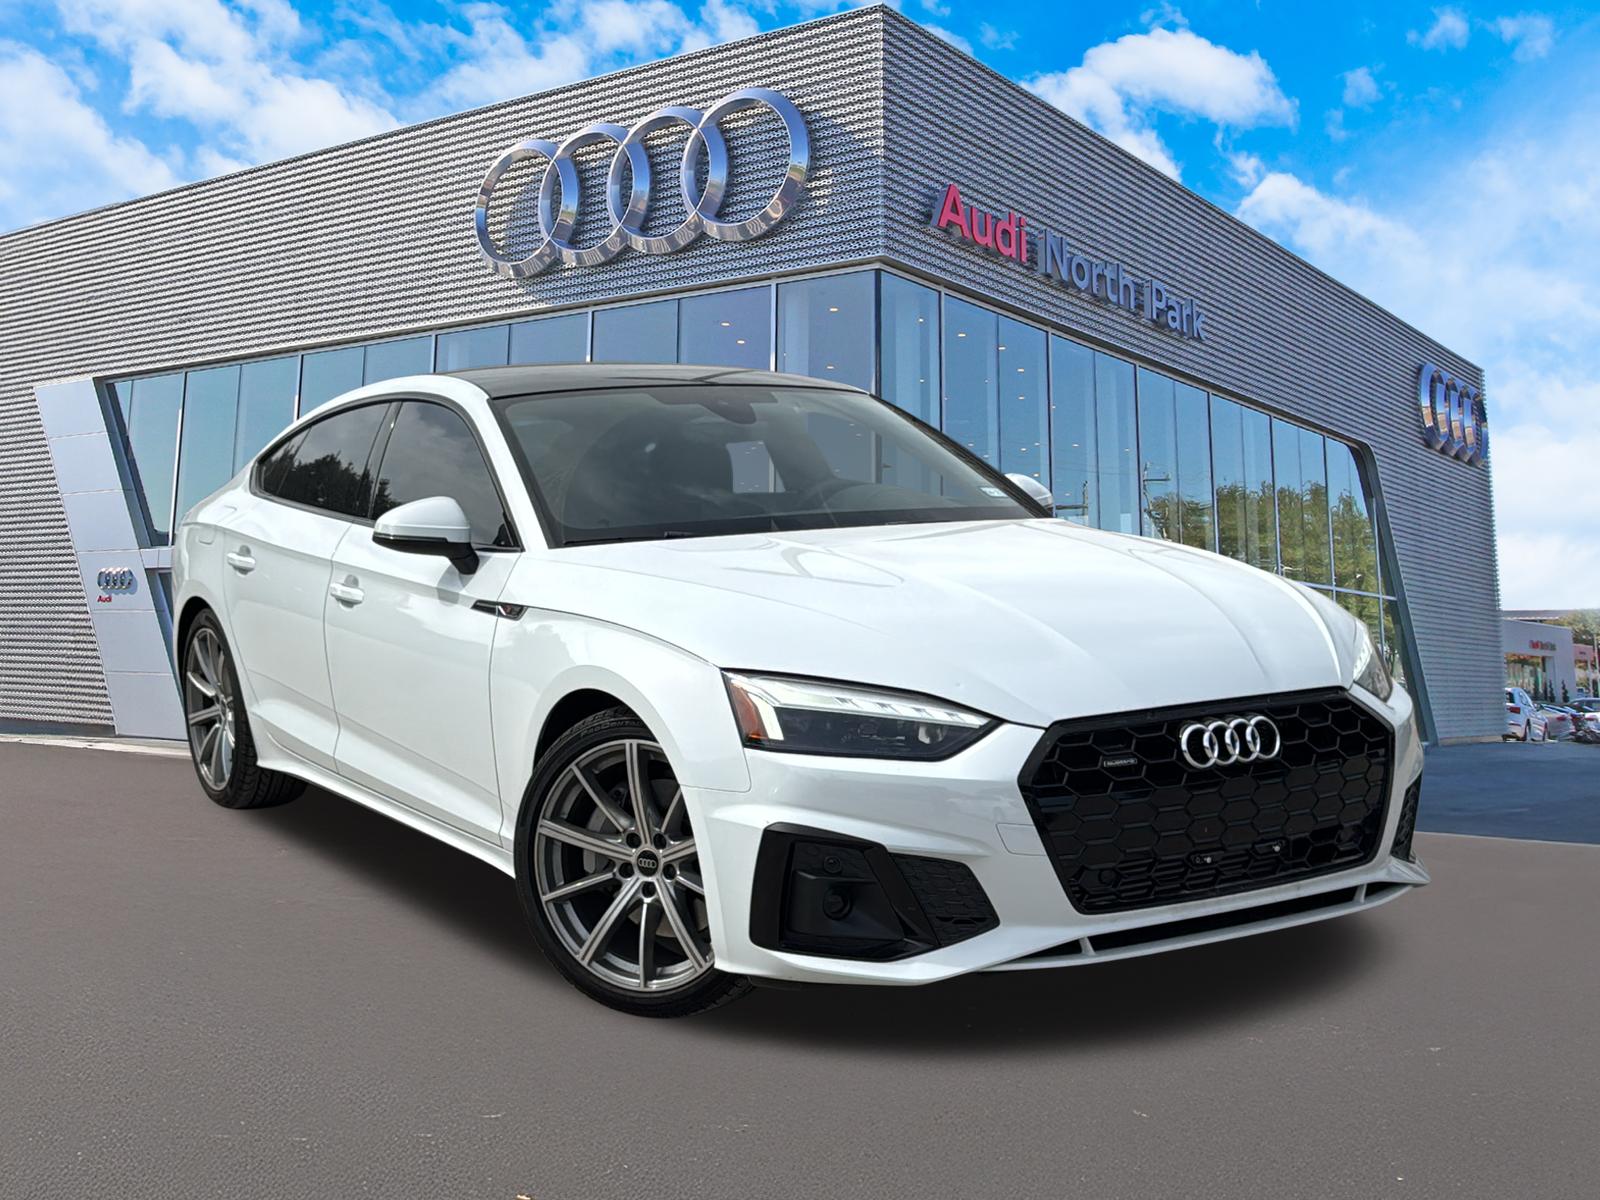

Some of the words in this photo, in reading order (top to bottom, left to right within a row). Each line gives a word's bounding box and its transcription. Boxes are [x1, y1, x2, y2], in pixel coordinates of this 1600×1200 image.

[935, 183, 1028, 264] Audi
[1042, 229, 1137, 311] North
[1146, 279, 1207, 341] Park
[97, 595, 112, 603] Audi
